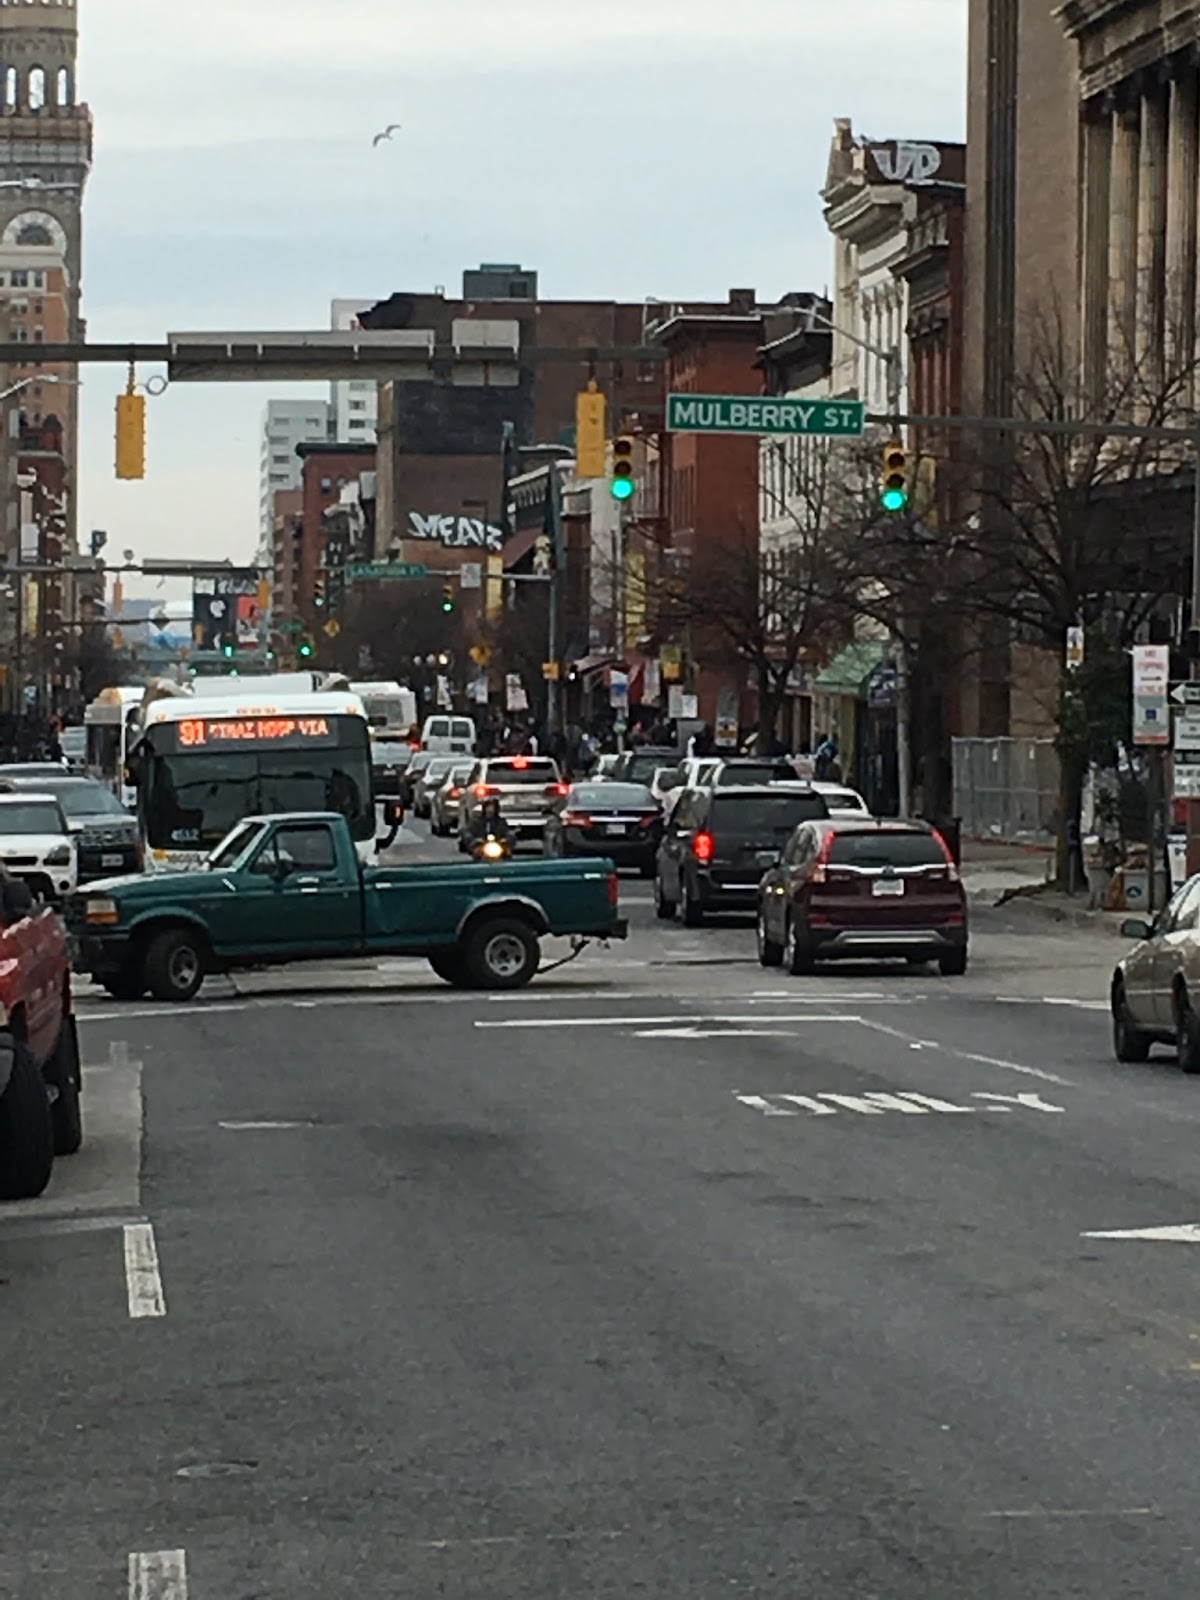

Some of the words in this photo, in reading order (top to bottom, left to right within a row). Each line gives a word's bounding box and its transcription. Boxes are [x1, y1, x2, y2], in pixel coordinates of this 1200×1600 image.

[674, 402, 815, 428] MULBERRY
[824, 407, 858, 428] ST.
[179, 721, 207, 745] 91
[298, 719, 329, 736] VIA
[733, 1091, 1066, 1116] ONLY
